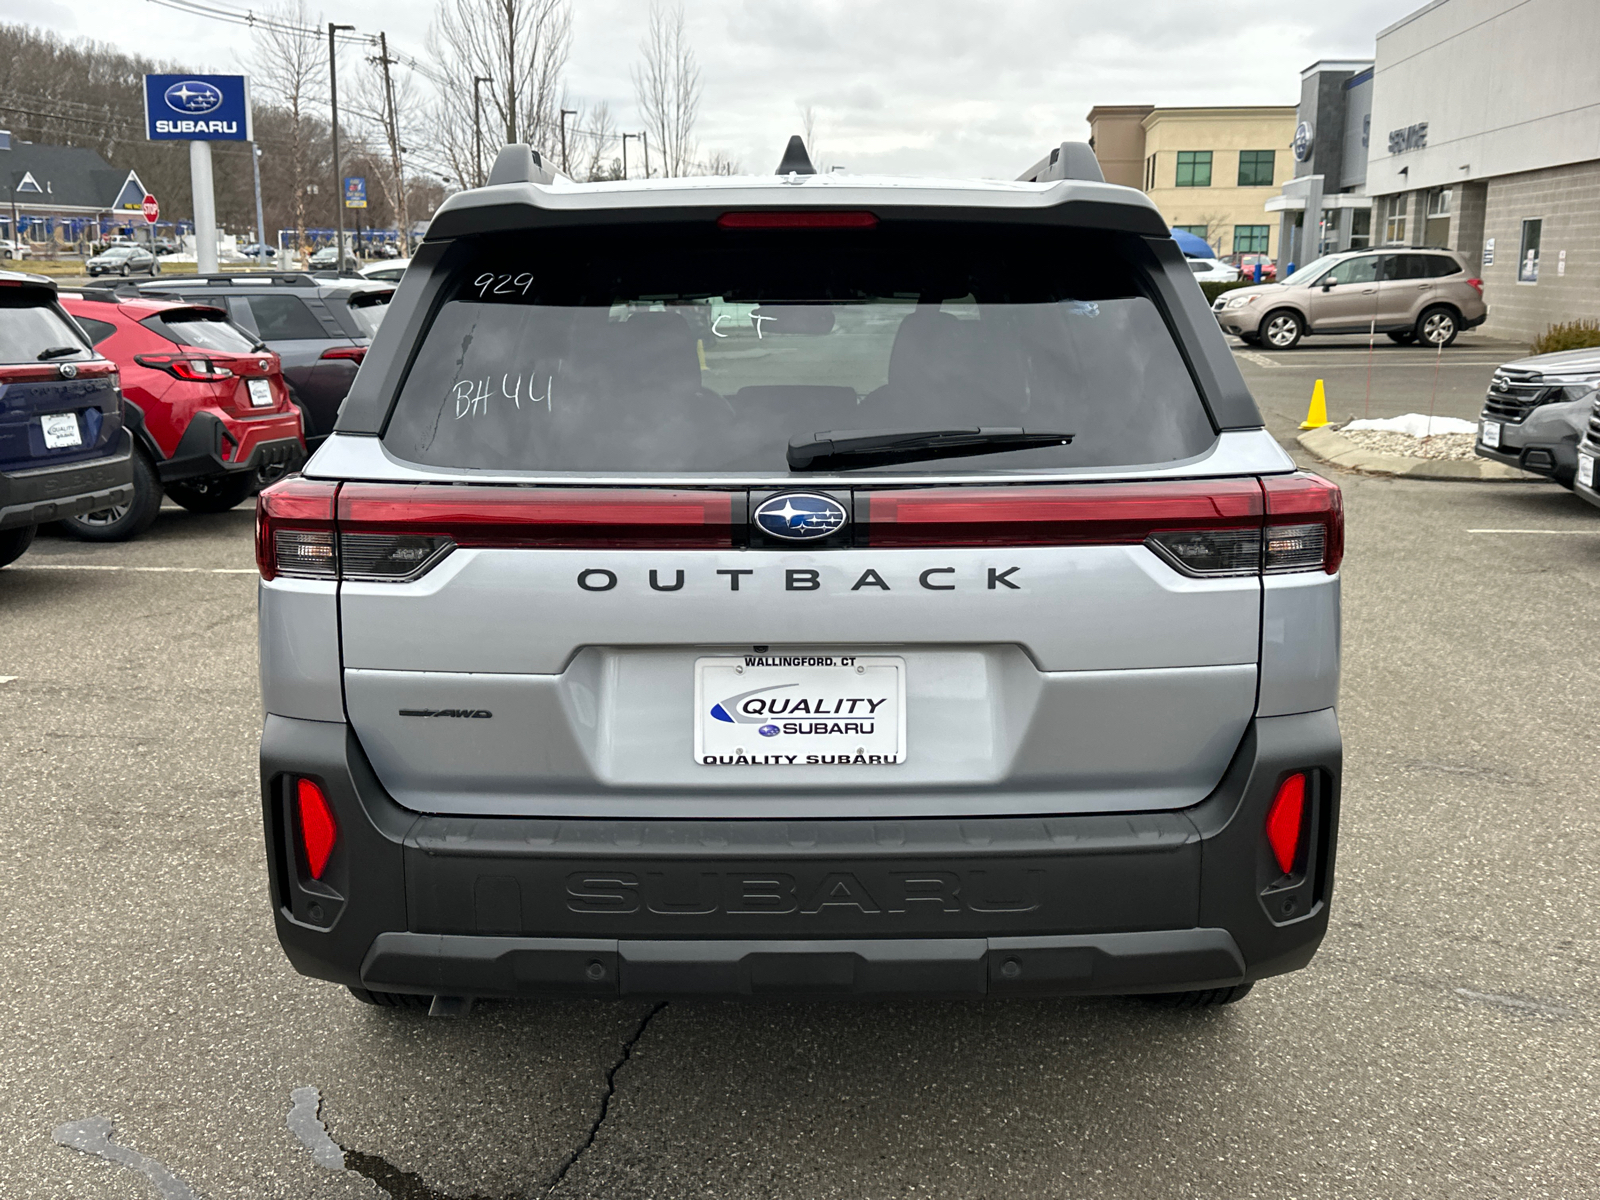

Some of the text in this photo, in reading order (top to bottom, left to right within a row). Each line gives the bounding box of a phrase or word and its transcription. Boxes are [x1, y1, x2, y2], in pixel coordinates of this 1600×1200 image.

[155, 120, 238, 134] SUBARU
[143, 203, 158, 216] STOP
[474, 272, 534, 298] 929
[577, 566, 1022, 592] OUTBACK
[744, 657, 856, 667] WALLINGFORD, CT
[433, 709, 493, 718] AWD
[742, 698, 887, 716] QUALITY
[783, 723, 875, 735] SUBARU
[703, 754, 898, 765] QUALITY SUBARU
[566, 869, 1046, 915] SUBARU
